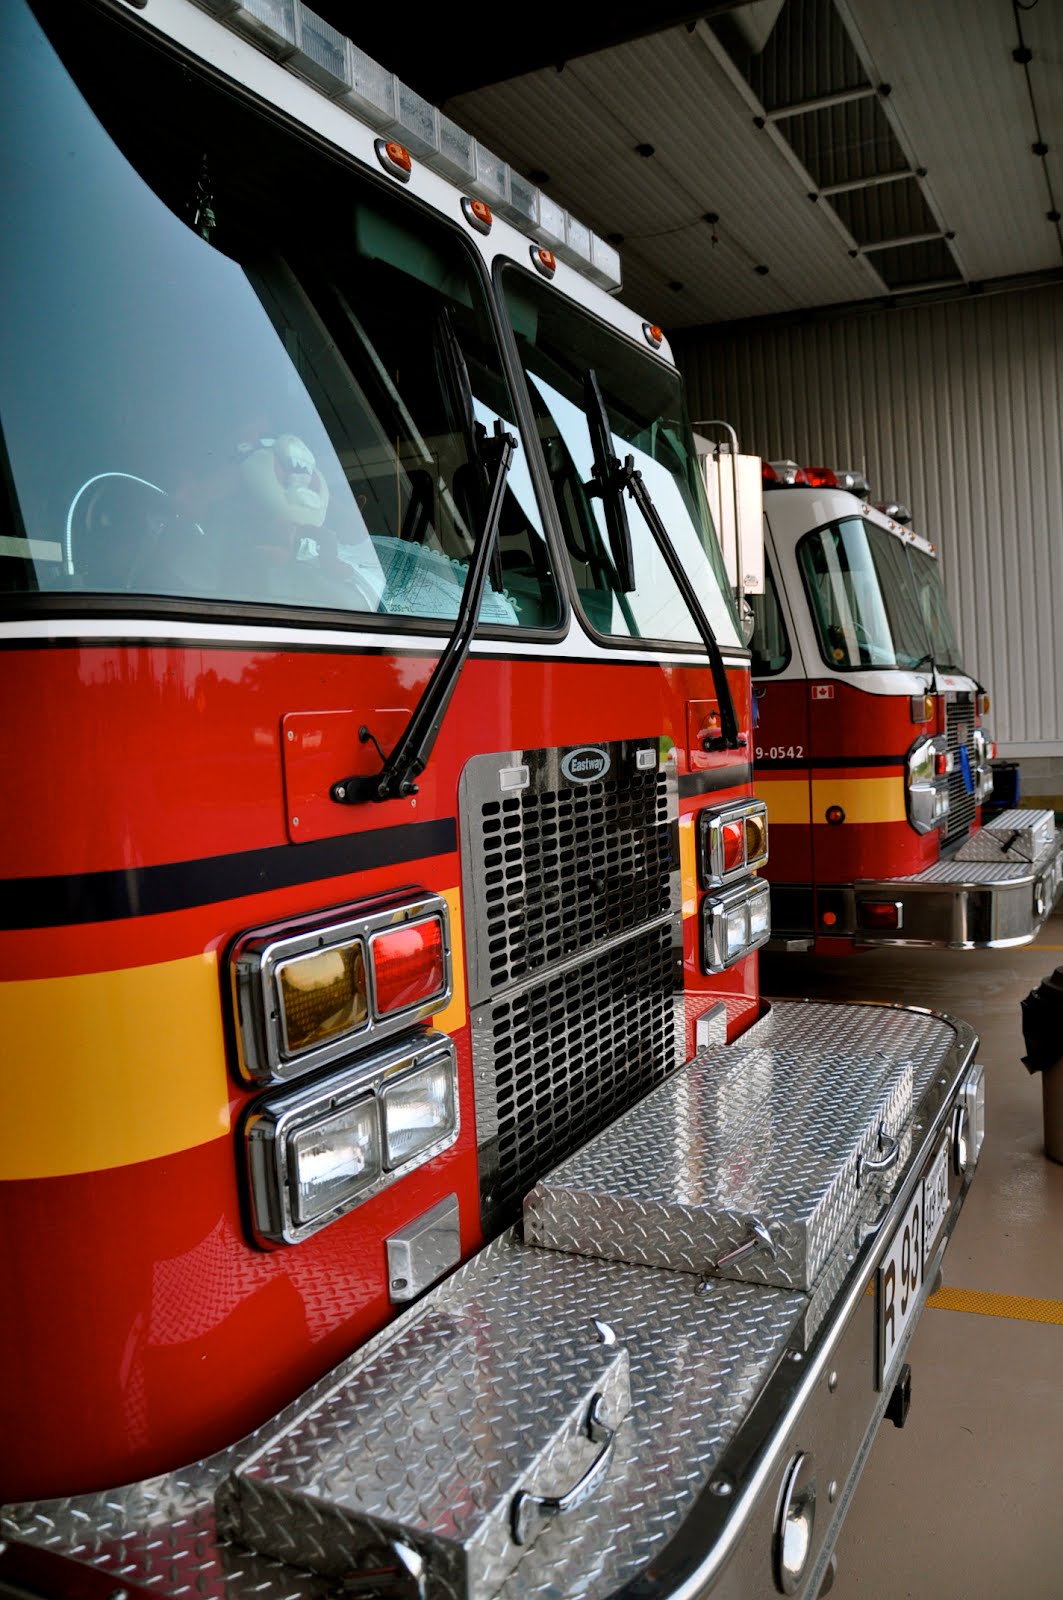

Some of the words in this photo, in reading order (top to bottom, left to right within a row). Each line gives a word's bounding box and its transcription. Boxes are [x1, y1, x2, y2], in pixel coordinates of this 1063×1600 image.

[755, 746, 804, 759] 9-0542
[571, 758, 603, 772] Eastway
[901, 1204, 920, 1316] 93
